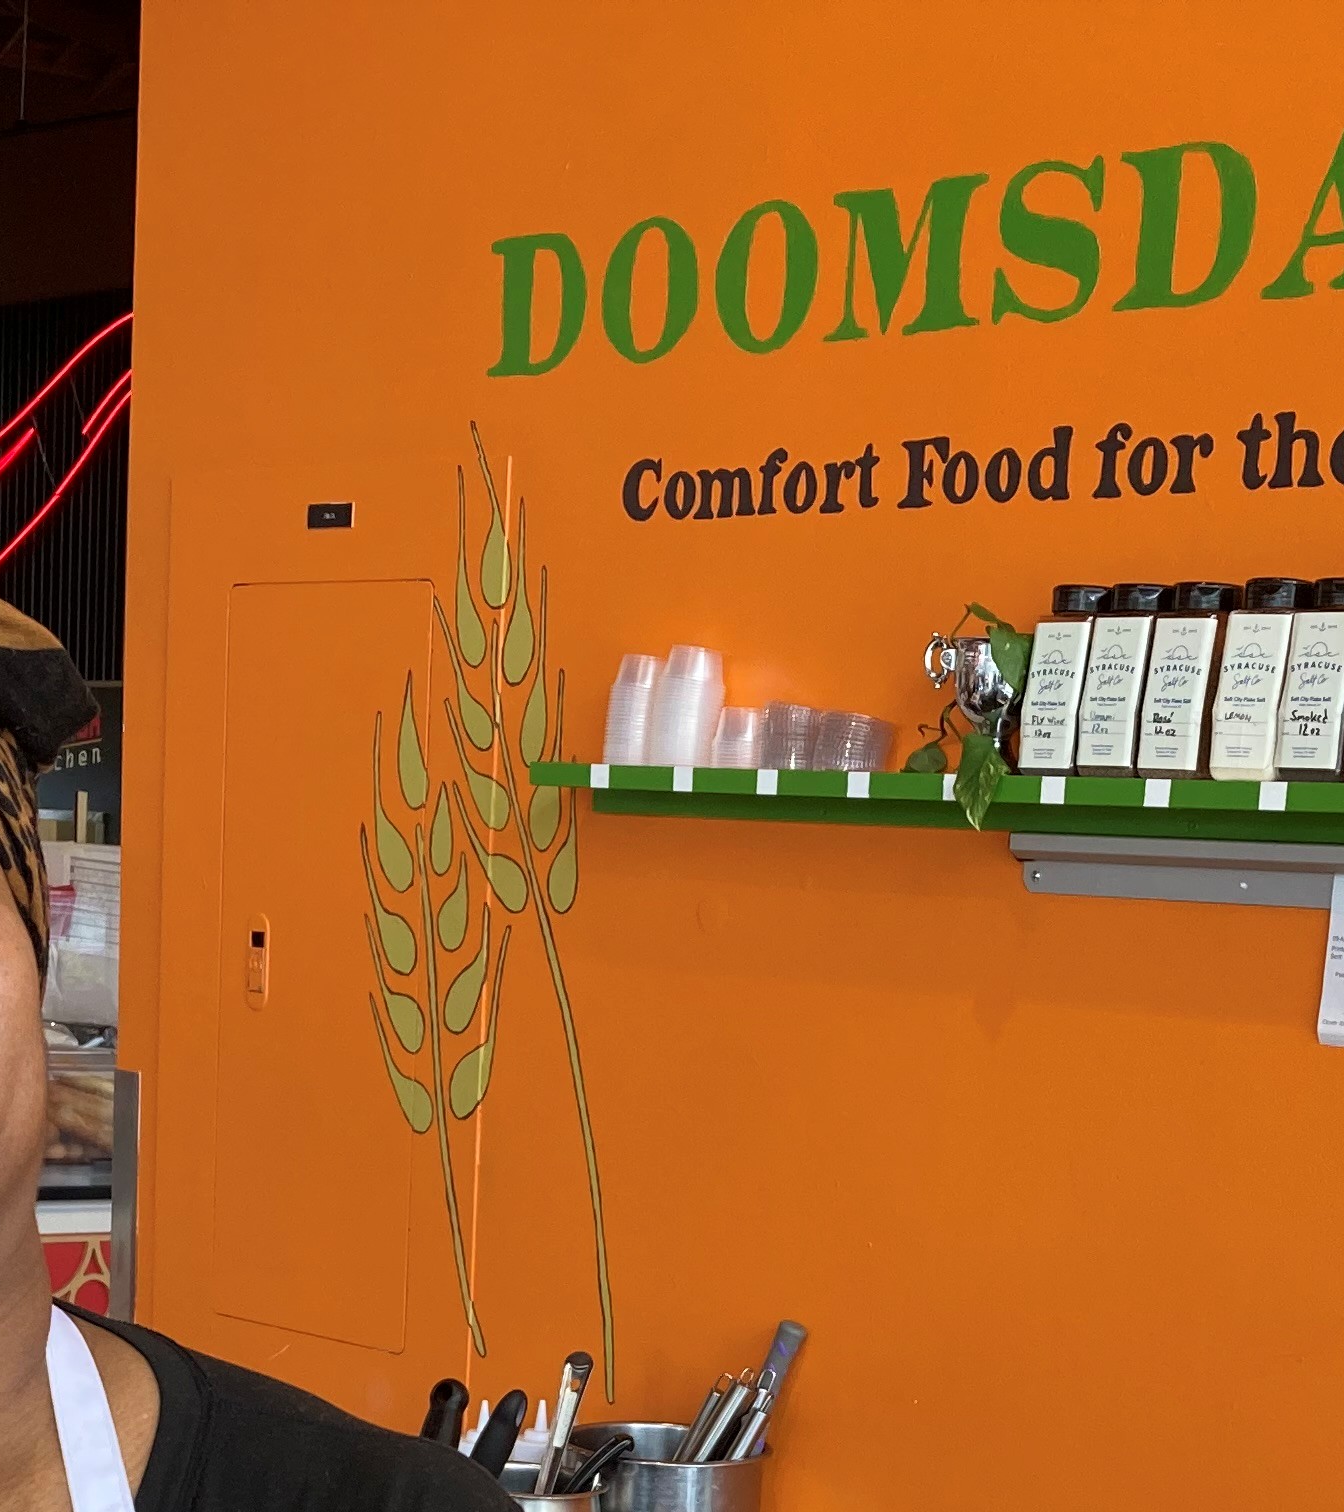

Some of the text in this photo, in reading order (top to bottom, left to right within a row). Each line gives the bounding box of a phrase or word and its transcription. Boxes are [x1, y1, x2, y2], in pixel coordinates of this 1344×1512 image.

[621, 446, 881, 523] Comfort
[899, 427, 1072, 508] Food
[1094, 421, 1214, 499] for
[1031, 667, 1075, 679] SYRACUSE
[1089, 663, 1136, 675] SYRACUSE
[1154, 664, 1202, 676] SYRACUSE
[1223, 661, 1277, 674] SYRACUSE
[1290, 661, 1343, 673] SYRACUSE
[1289, 708, 1328, 724] Smoked
